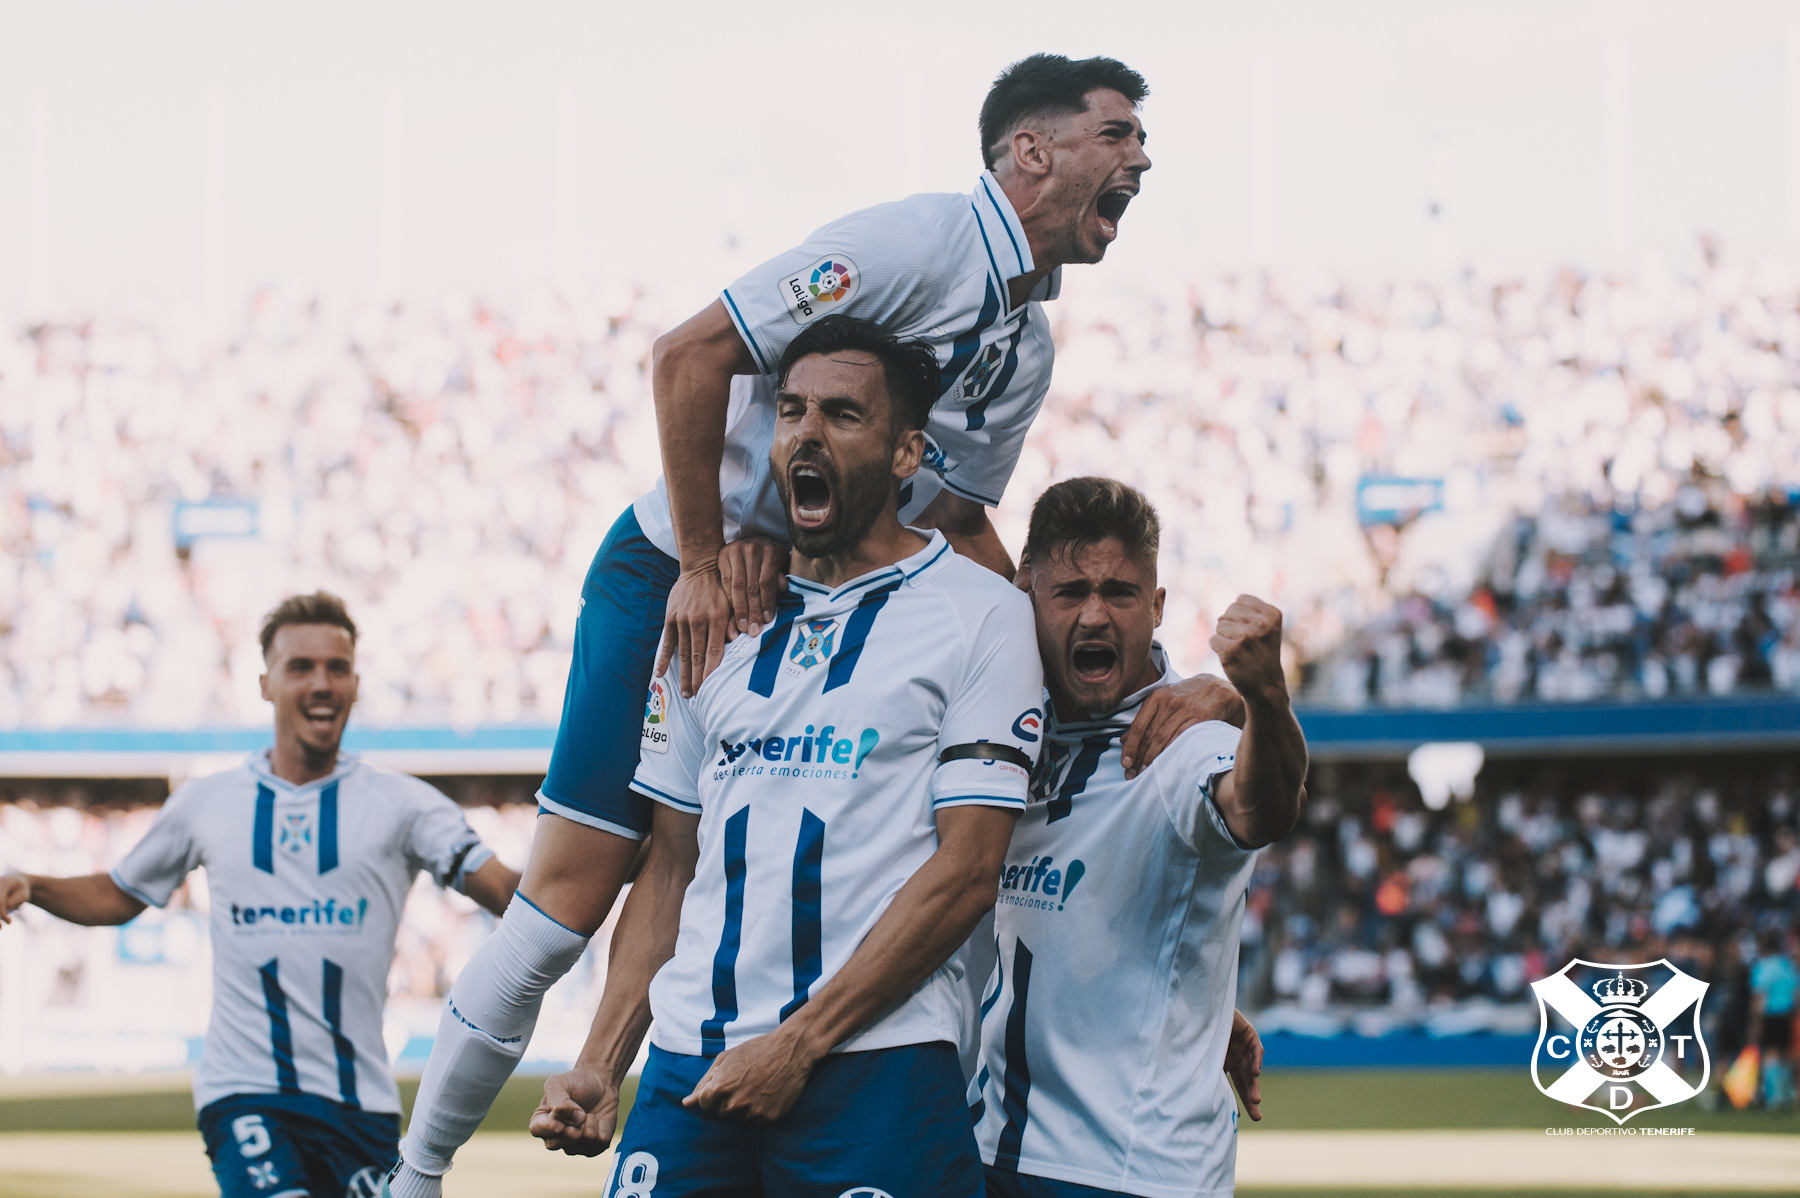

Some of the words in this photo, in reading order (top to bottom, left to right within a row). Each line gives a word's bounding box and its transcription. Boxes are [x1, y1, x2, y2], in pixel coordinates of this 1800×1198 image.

[789, 278, 813, 317] LaLiga
[641, 727, 668, 743] aLiga
[770, 766, 848, 780] emociones
[1005, 895, 1055, 911] emociones
[232, 1114, 272, 1159] 5
